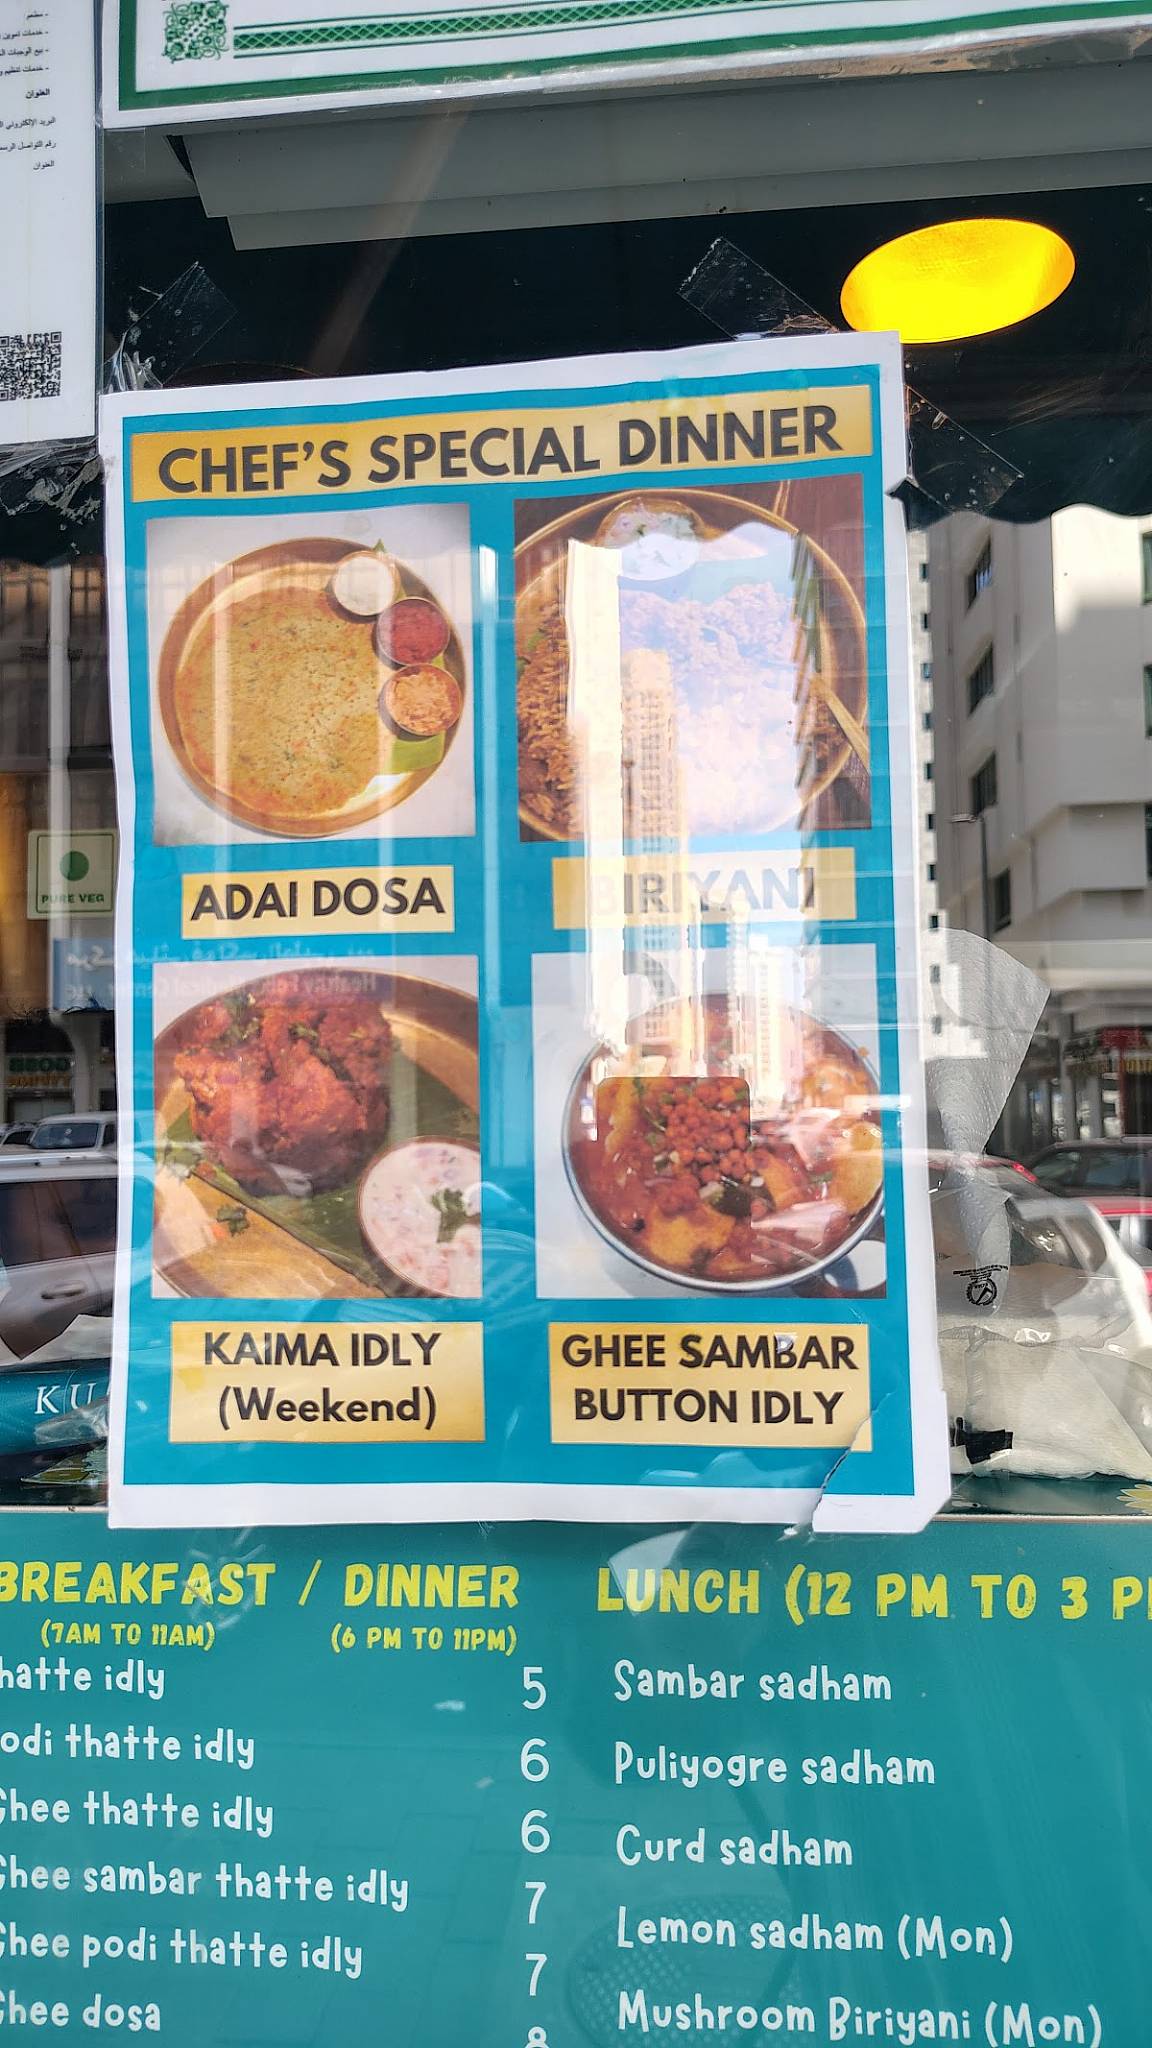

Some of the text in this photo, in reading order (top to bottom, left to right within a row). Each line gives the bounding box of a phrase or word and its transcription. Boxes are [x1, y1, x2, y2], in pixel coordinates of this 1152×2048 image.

[25, 88, 50, 99] العنوان
[33, 160, 55, 171] العنوان
[367, 426, 601, 484] SPECIAL
[618, 404, 844, 467] DINNER
[79, 893, 104, 903] VEG
[190, 877, 446, 921] ADAI DOSA
[204, 1332, 441, 1367] KAIMA IDLY
[561, 1334, 859, 1370] GHEE SAMBAR
[34, 1381, 111, 1415] KU
[219, 1385, 436, 1431] (Weekend)
[574, 1388, 844, 1425] BUTTON IDLY
[0, 1558, 518, 1607] BREAKFAST / DINNER
[598, 1565, 1152, 1625] LUNCH (12 PM TO 3 P
[41, 1620, 215, 1651] (7AM TO 11AM)
[330, 1622, 518, 1657] (6 PM TO 11PM)
[0, 1656, 165, 1700] hatte idly
[523, 1666, 547, 1710] 5
[614, 1659, 891, 1701] Sambar sadham
[0, 1723, 254, 1770] odi thatte idly
[520, 1738, 550, 1782] 6
[615, 1741, 935, 1788] Puliyogre sadham
[83, 1790, 199, 1828] thatte
[212, 1795, 273, 1838] idly
[521, 1809, 550, 1854] 6
[616, 1824, 852, 1866] Curd sadham
[83, 1861, 202, 1895] sambar
[215, 1862, 333, 1901] thatte
[347, 1868, 408, 1912] idly
[525, 1881, 547, 1924] 7
[83, 1927, 156, 1968] podi
[170, 1928, 288, 1968] thatte
[301, 1935, 362, 1979] idly
[617, 1905, 1013, 1963] Lemon sadham (Mon)
[525, 1953, 547, 1996] 7
[83, 1993, 161, 2032] dosa
[618, 1989, 1102, 2048] Mushroom Biriyani (Mon)
